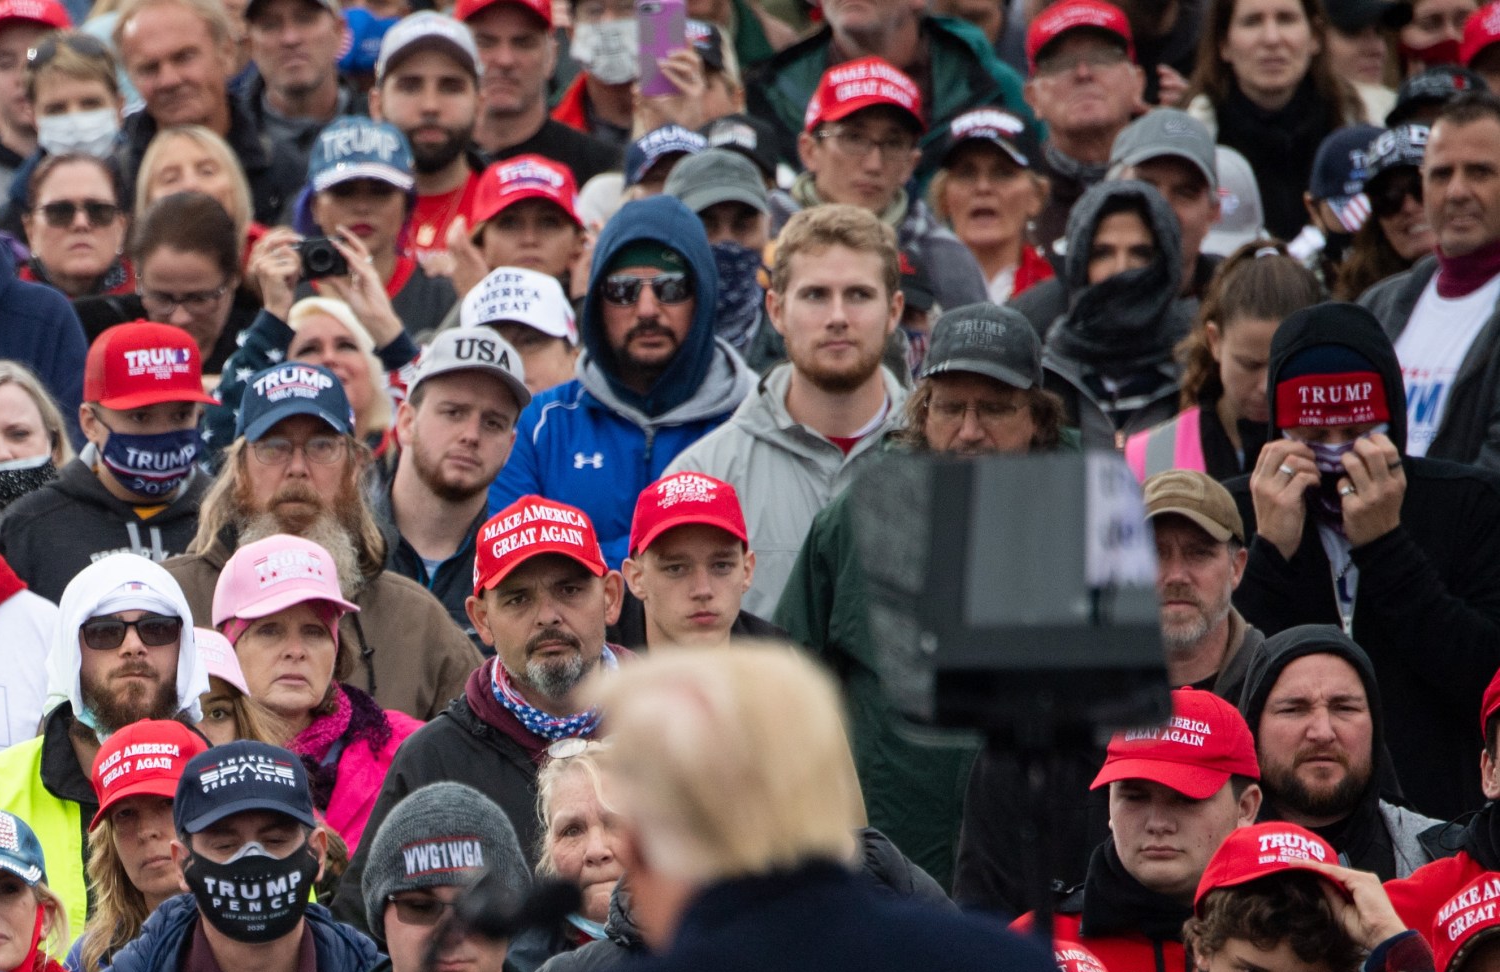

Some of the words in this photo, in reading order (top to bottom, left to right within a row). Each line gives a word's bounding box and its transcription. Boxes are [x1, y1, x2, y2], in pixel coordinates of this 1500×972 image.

[828, 65, 868, 87] MAKE
[835, 80, 877, 103] GREAT
[320, 125, 400, 163] TRUMP
[954, 319, 1007, 337] TRUMP
[962, 333, 994, 346] 2020
[455, 338, 511, 372] USA
[252, 366, 334, 396] TRUMP
[1298, 381, 1373, 405] TRUMP
[126, 443, 196, 471] TRUMP
[657, 474, 717, 495] TRUMP
[665, 485, 707, 498] 2020
[483, 510, 522, 542] MAKE
[522, 504, 588, 529] AMERICA
[492, 528, 537, 559] GREAT
[539, 525, 584, 547] AGAIN
[1161, 731, 1204, 747] AGAIN
[98, 750, 123, 776] MAKE
[123, 743, 180, 759] AMERICA
[228, 756, 264, 765] MAKE
[102, 762, 132, 788] GREAT
[136, 757, 172, 771] AGAIN
[199, 763, 295, 786] SPACE
[201, 775, 245, 793] GREAT
[254, 773, 296, 787] AGAIN
[403, 840, 485, 875] WWG1WGA
[1258, 833, 1326, 862] TRUMP
[1280, 847, 1310, 860] 2020
[1258, 855, 1276, 864] KEEP
[203, 870, 302, 900] TRUMP
[212, 892, 297, 912] PENCE
[1438, 885, 1479, 926] MAKE
[221, 912, 237, 920] KEEP
[1447, 903, 1496, 941] GREAT
